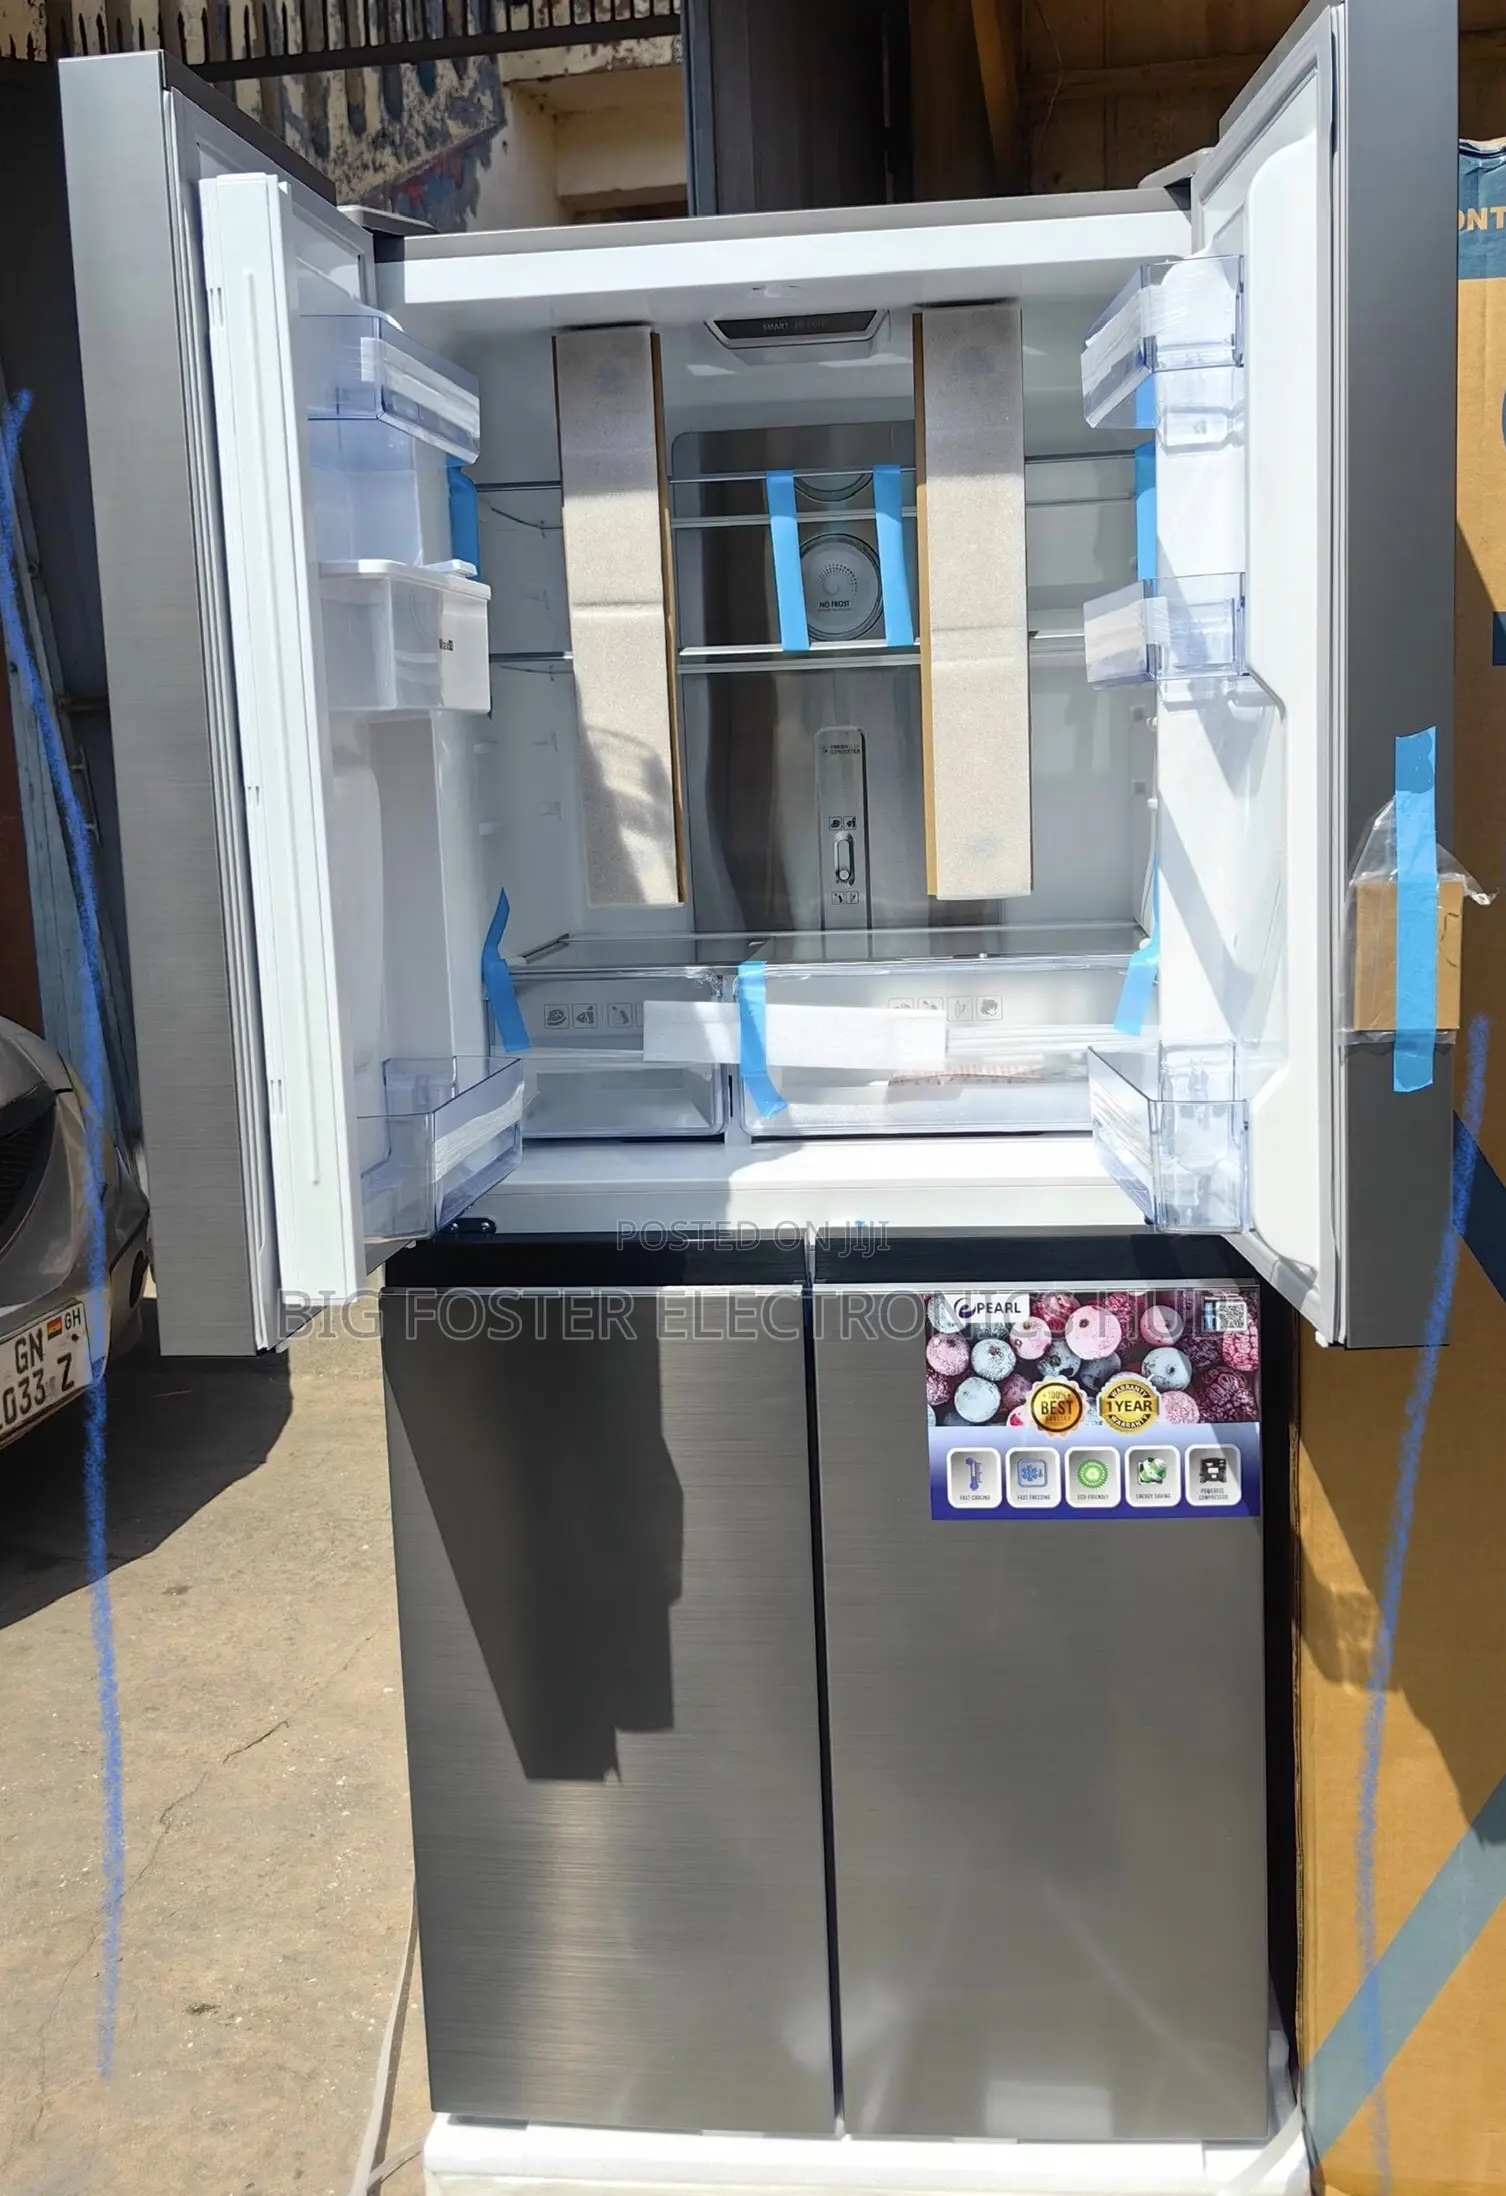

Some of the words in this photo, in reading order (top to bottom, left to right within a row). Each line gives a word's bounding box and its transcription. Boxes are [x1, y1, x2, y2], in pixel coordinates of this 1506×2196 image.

[831, 600, 850, 608] FROST
[976, 1302, 1022, 1315] PEARL
[64, 1307, 82, 1330] GH
[15, 1328, 44, 1375] GN
[0, 1368, 46, 1430] 033
[57, 1352, 75, 1392] Z
[1109, 1383, 1150, 1399] WARRANTY
[1041, 1400, 1074, 1415] BEST
[1106, 1400, 1112, 1412] 1
[1114, 1400, 1153, 1413] YEAR
[1109, 1413, 1151, 1430] WARRANTY
